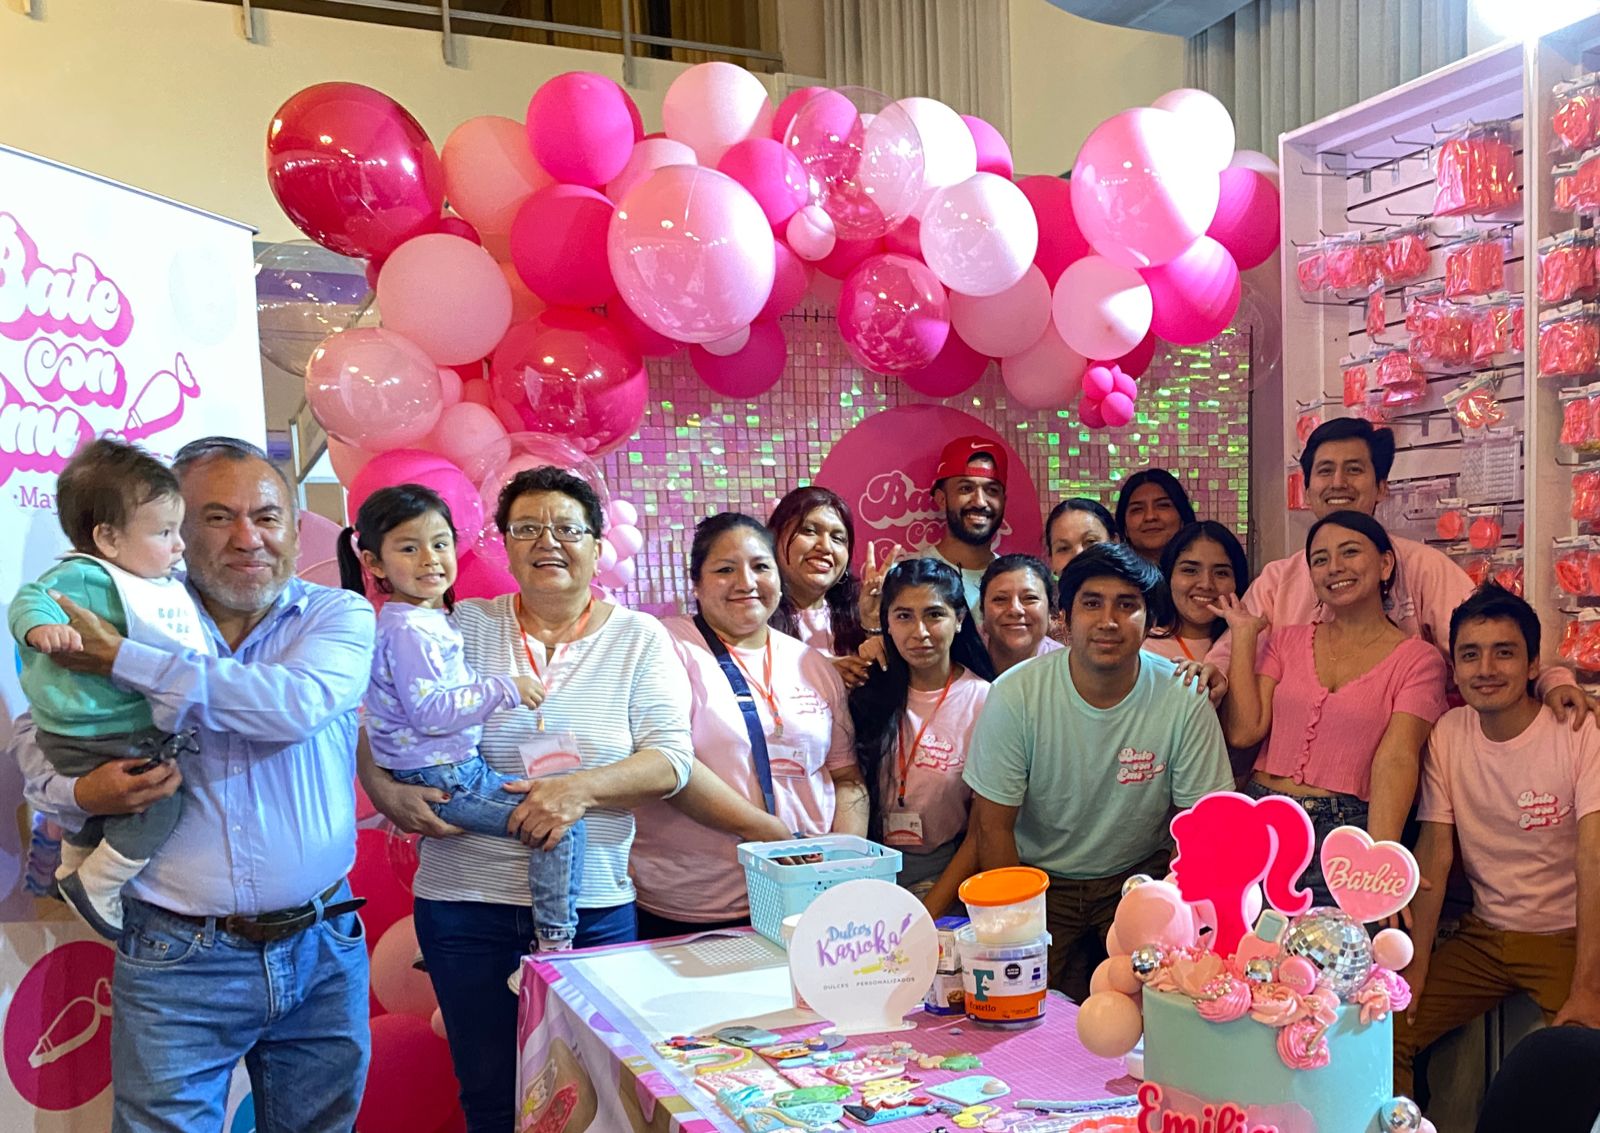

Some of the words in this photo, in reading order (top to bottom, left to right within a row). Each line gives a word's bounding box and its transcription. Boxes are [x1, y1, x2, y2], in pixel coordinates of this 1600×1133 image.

[1326, 856, 1407, 898] Barbie
[816, 919, 902, 968] Karioka
[827, 921, 872, 942] Dulces
[823, 982, 849, 991] DULCES
[856, 976, 916, 987] PERSONALIZADOS
